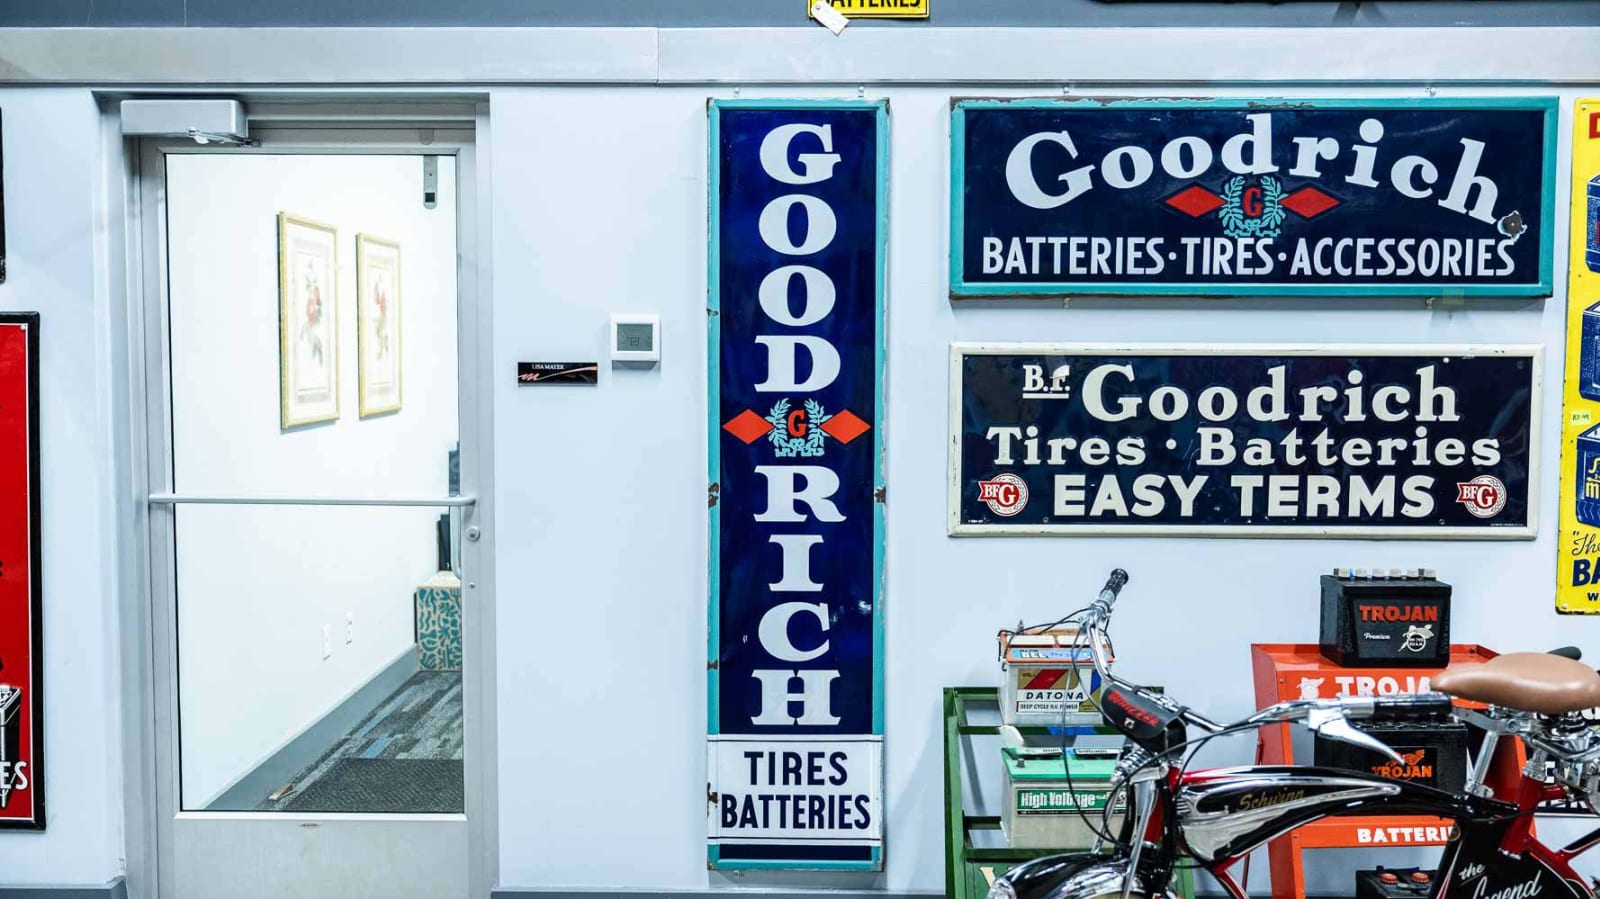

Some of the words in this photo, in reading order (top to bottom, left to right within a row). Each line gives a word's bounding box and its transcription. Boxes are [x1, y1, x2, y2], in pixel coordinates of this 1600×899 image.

[1005, 113, 1501, 225] Goodrich
[982, 236, 1164, 276] BATTERIES
[1181, 236, 1275, 276] TIRES
[1291, 237, 1515, 278] ACCESSORIES
[1082, 364, 1460, 424] Goodrich
[986, 426, 1146, 467] Tires
[1197, 426, 1501, 467] Batteries
[1054, 474, 1212, 519] EASY
[1231, 474, 1436, 519] TERMS
[1359, 605, 1438, 622] TROJAN
[1025, 691, 1084, 700] DATONA
[1335, 676, 1443, 697] TROJA
[744, 751, 848, 786] TIRES
[1371, 765, 1432, 778] TROJAN
[721, 793, 872, 830] BATTERIES
[1021, 792, 1047, 808] High
[1049, 792, 1096, 808] Voltage
[1240, 787, 1304, 810] Schwinn
[1459, 862, 1486, 880] the
